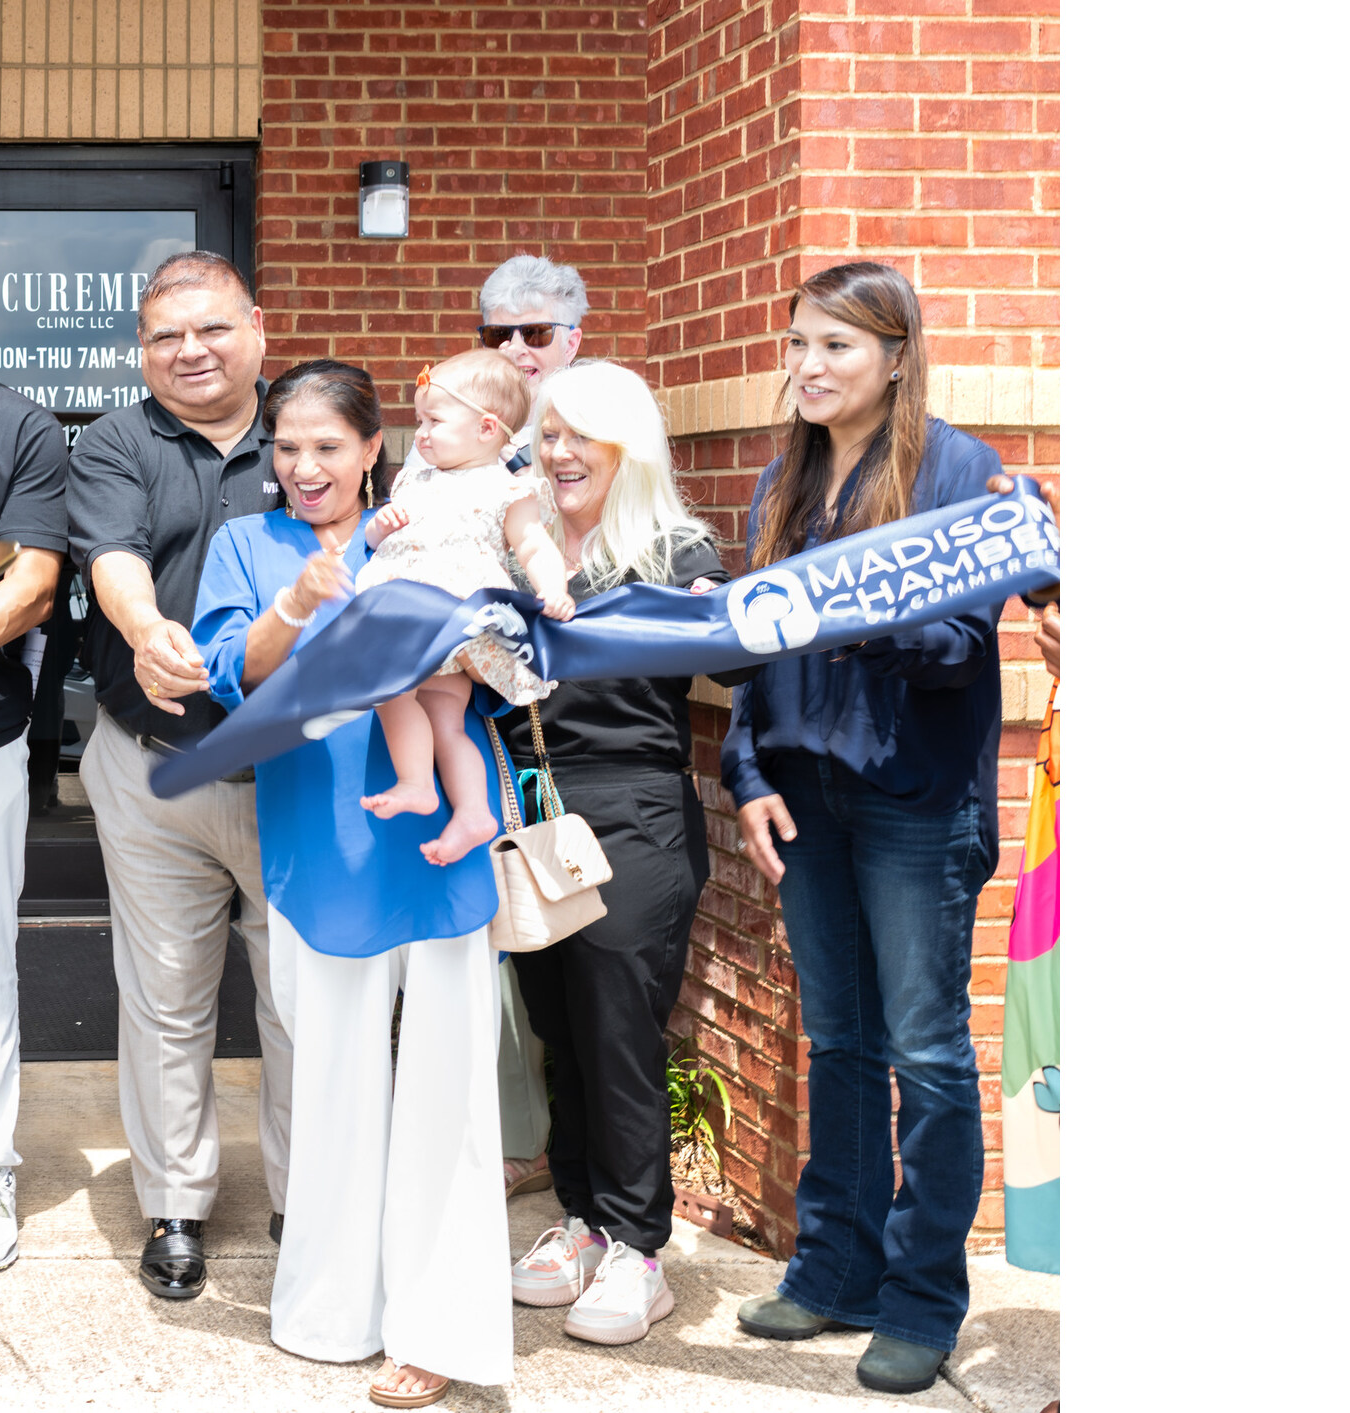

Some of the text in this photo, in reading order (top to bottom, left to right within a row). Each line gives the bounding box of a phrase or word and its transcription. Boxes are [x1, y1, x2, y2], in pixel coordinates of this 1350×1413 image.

[36, 316, 114, 329] CLINIC LLC
[806, 494, 1057, 597] MADISON
